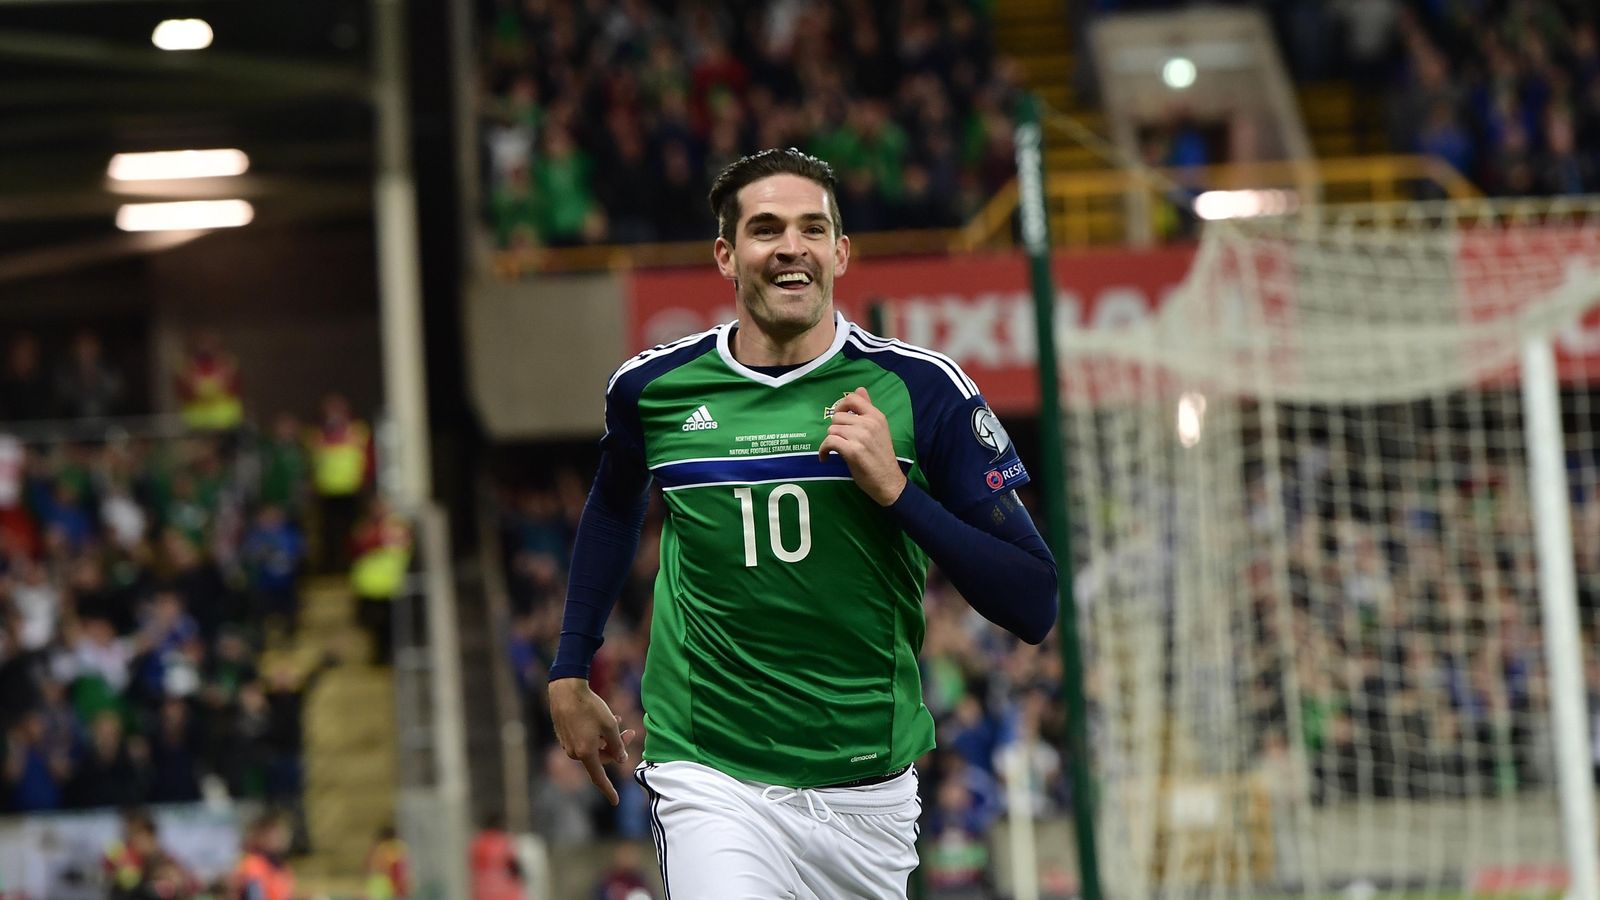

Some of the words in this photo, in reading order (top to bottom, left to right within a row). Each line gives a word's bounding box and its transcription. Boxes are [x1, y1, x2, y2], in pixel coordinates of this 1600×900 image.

[682, 419, 718, 431] adidas
[734, 484, 811, 567] 10
[850, 752, 877, 763] climacool
